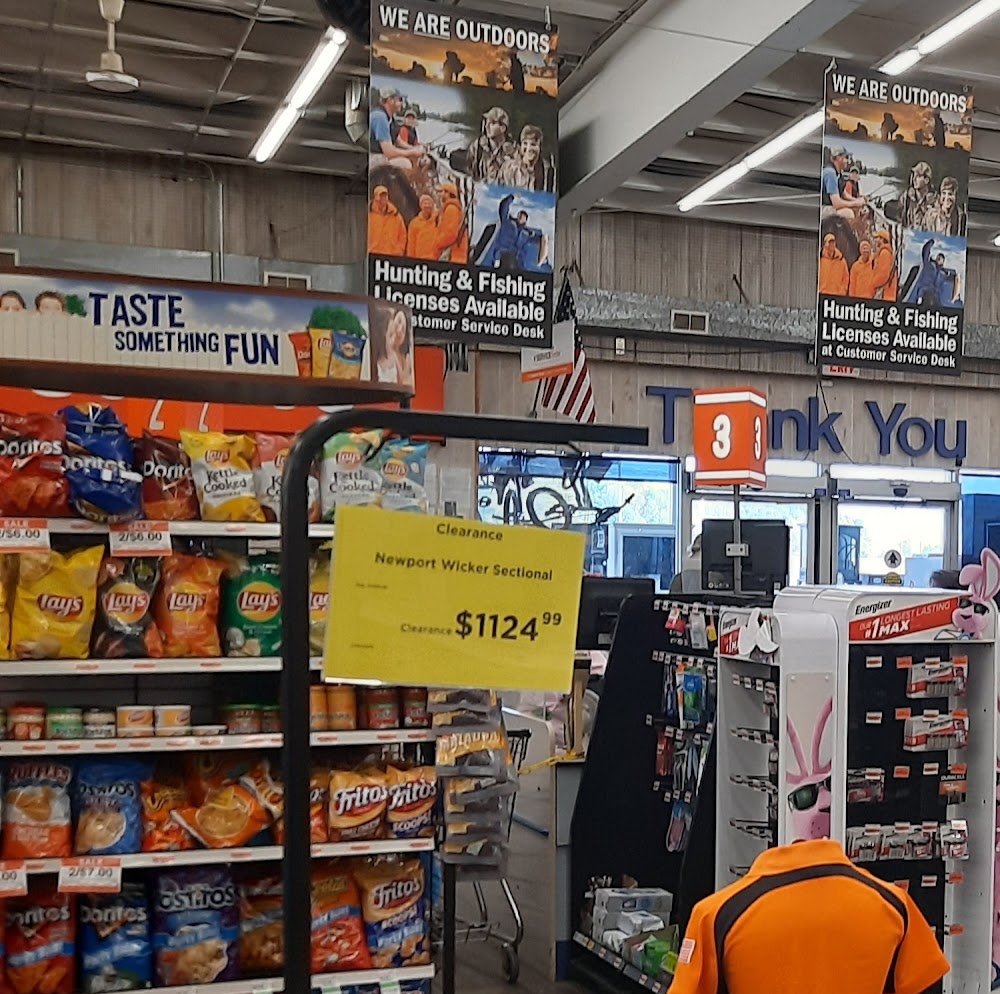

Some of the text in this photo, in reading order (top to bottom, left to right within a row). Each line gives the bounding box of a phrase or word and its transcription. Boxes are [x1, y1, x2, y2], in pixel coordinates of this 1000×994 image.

[379, 4, 550, 54] WE ARE OUTDOORS
[832, 73, 967, 113] WE ARE OUTDOORS
[374, 259, 546, 303] Hunting & Fishing
[88, 291, 186, 329] TASTE
[374, 284, 546, 323] Licenses Available
[822, 299, 959, 335] Hunting & Fishing
[461, 317, 509, 336] Service
[513, 322, 546, 340] Desk
[822, 321, 957, 353] Licenses Available
[113, 329, 280, 367] SOMETHING FUN
[821, 344, 956, 368] at Customer Service Desk
[645, 386, 968, 459] Tnk You
[711, 413, 733, 460] 3
[753, 415, 762, 462] 3
[143, 460, 193, 479] Dorito
[203, 478, 248, 493] Cooked
[436, 522, 503, 542] Clearance
[374, 551, 553, 581] Newport Wicker Sectional
[854, 599, 893, 616] Energizer
[880, 609, 916, 625] LONGEST
[915, 600, 951, 616] LASTING
[400, 609, 562, 642] Clearance $1124 99
[879, 619, 911, 638] MAX
[335, 784, 388, 816] Fritos
[388, 779, 437, 810] Fritos
[373, 878, 421, 909] Fritos
